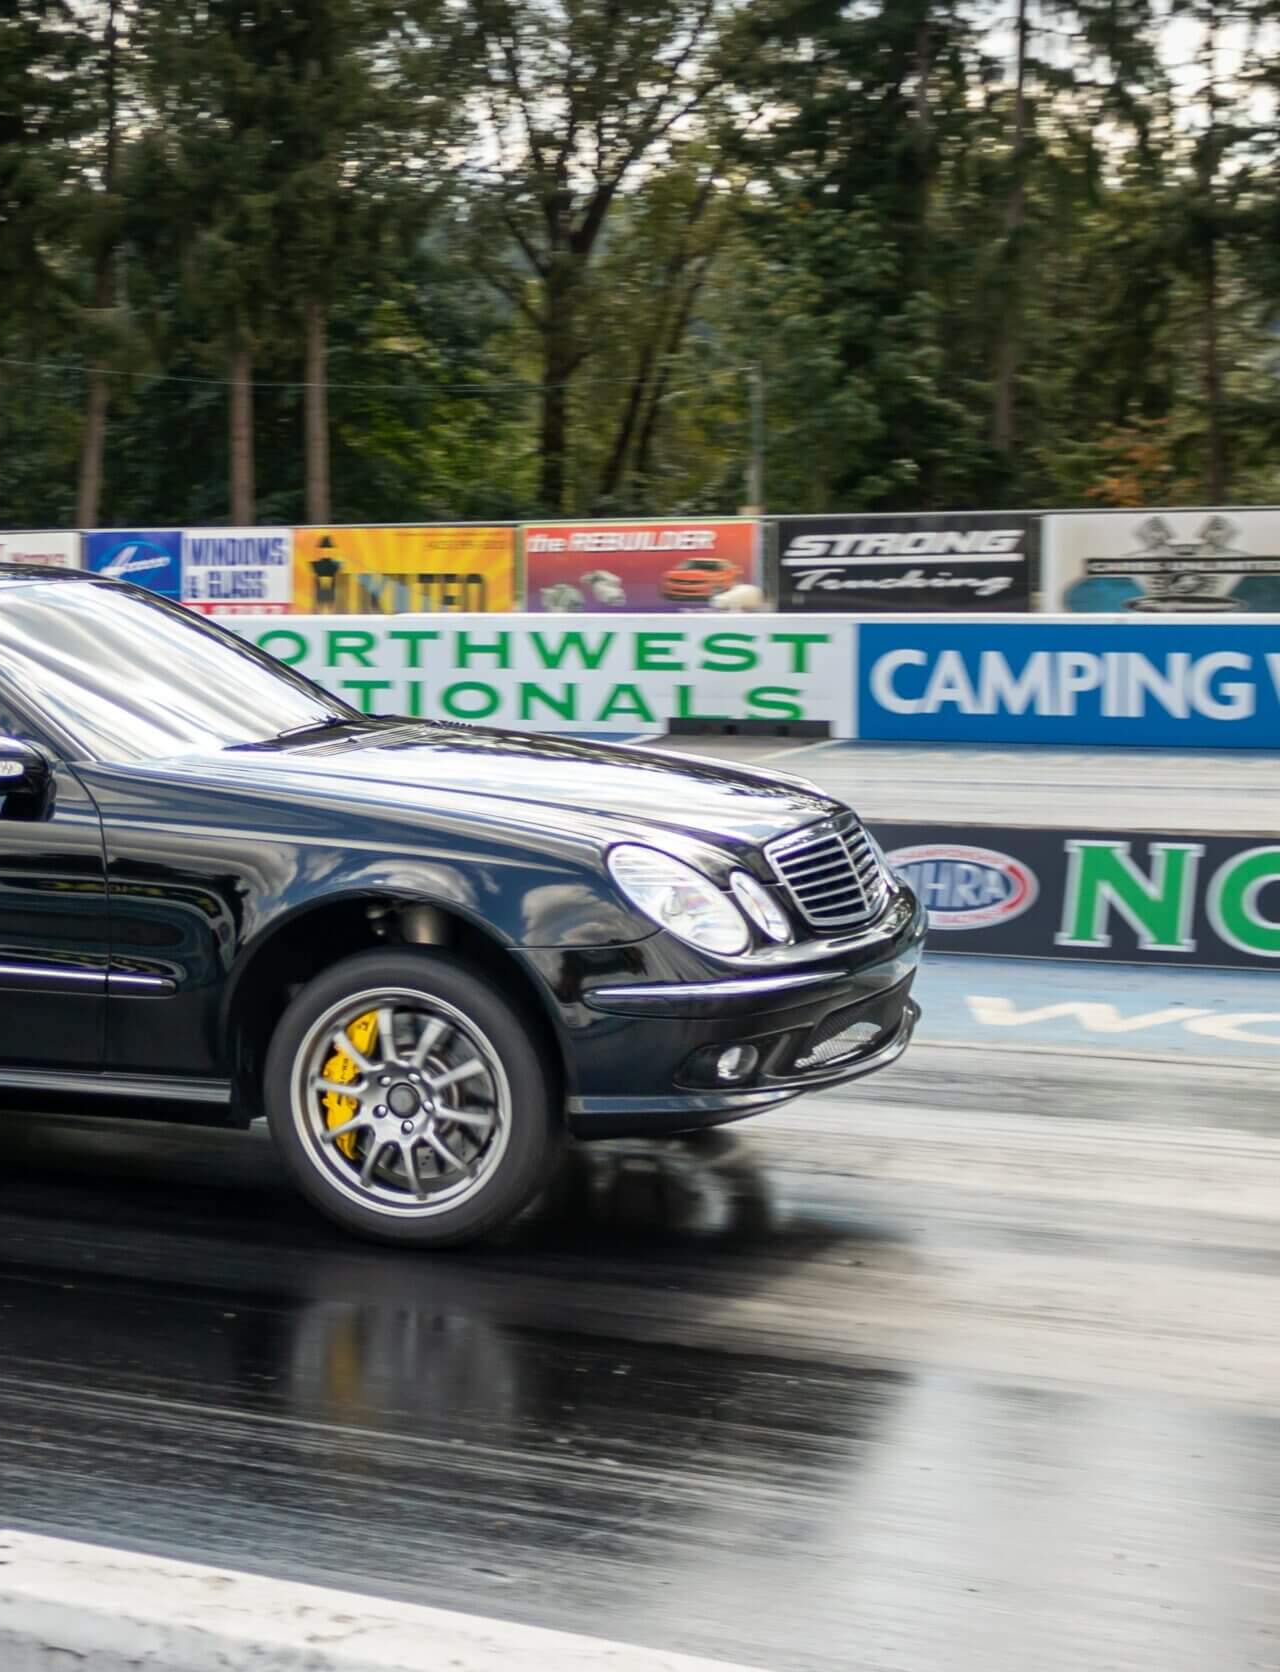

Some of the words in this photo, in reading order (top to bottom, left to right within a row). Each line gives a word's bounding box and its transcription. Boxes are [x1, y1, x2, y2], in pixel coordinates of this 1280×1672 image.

[187, 538, 285, 566] WINDOWS
[527, 535, 567, 552] the
[570, 530, 717, 551] REBUILDER
[783, 530, 1025, 557] STRONG
[208, 571, 265, 598] GLASS
[792, 568, 1014, 595] Trucking
[256, 630, 832, 673] ORTHWEST
[869, 648, 1257, 721] CAMPING
[337, 679, 805, 721] TIONALS
